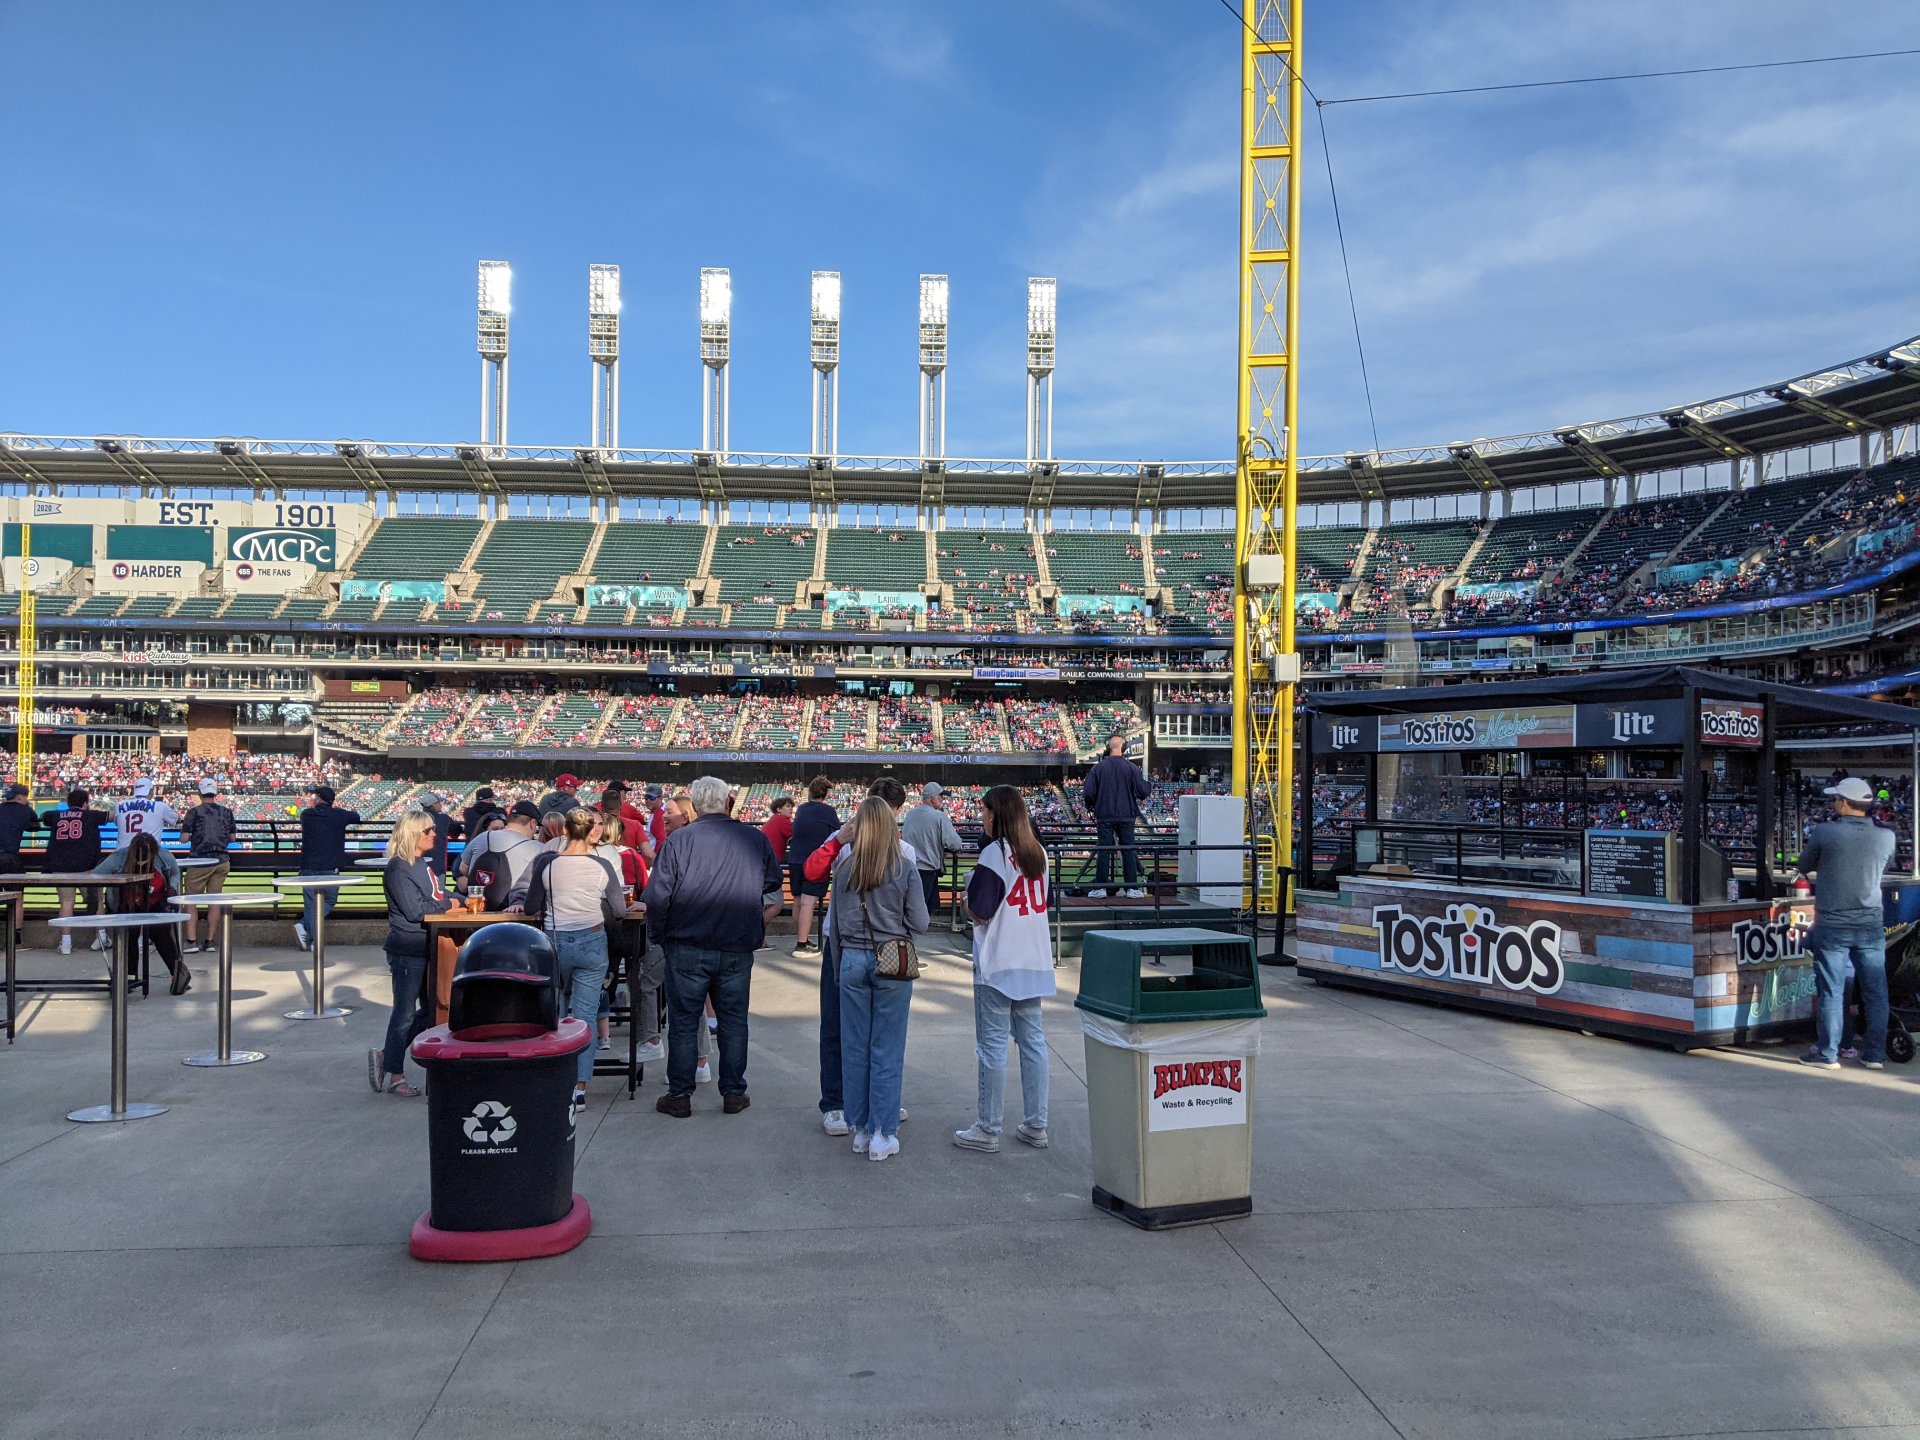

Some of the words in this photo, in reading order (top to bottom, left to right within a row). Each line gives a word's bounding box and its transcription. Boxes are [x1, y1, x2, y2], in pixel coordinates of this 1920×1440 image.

[37, 504, 52, 512] 2020
[159, 502, 219, 525] EST.
[275, 504, 336, 527] 1901
[115, 565, 127, 576] 18
[131, 565, 182, 578] HARDER
[238, 568, 250, 576] 455
[257, 568, 271, 577] THE
[272, 568, 291, 577] FANS
[123, 651, 147, 663] kids
[147, 651, 190, 660] Clubhouse
[669, 664, 688, 675] drug
[689, 665, 709, 673] mart
[711, 663, 734, 675] CLUB
[750, 666, 770, 676] drug
[792, 665, 815, 677] CLUB
[1087, 671, 1124, 679] COMPANIES
[9, 711, 25, 724] THE
[28, 711, 61, 725] CORNER
[1479, 711, 1540, 744] Nachos
[1612, 711, 1655, 742] Lite
[1331, 725, 1359, 749] Lite
[56, 820, 83, 840] 28
[124, 814, 144, 834] 12
[1006, 874, 1048, 917] 40
[1750, 964, 1817, 1018] Nacho
[1154, 1060, 1241, 1099] RUMPKE
[1162, 1101, 1185, 1109] Waste
[1187, 1099, 1194, 1107] &
[1196, 1097, 1233, 1107] Recycling
